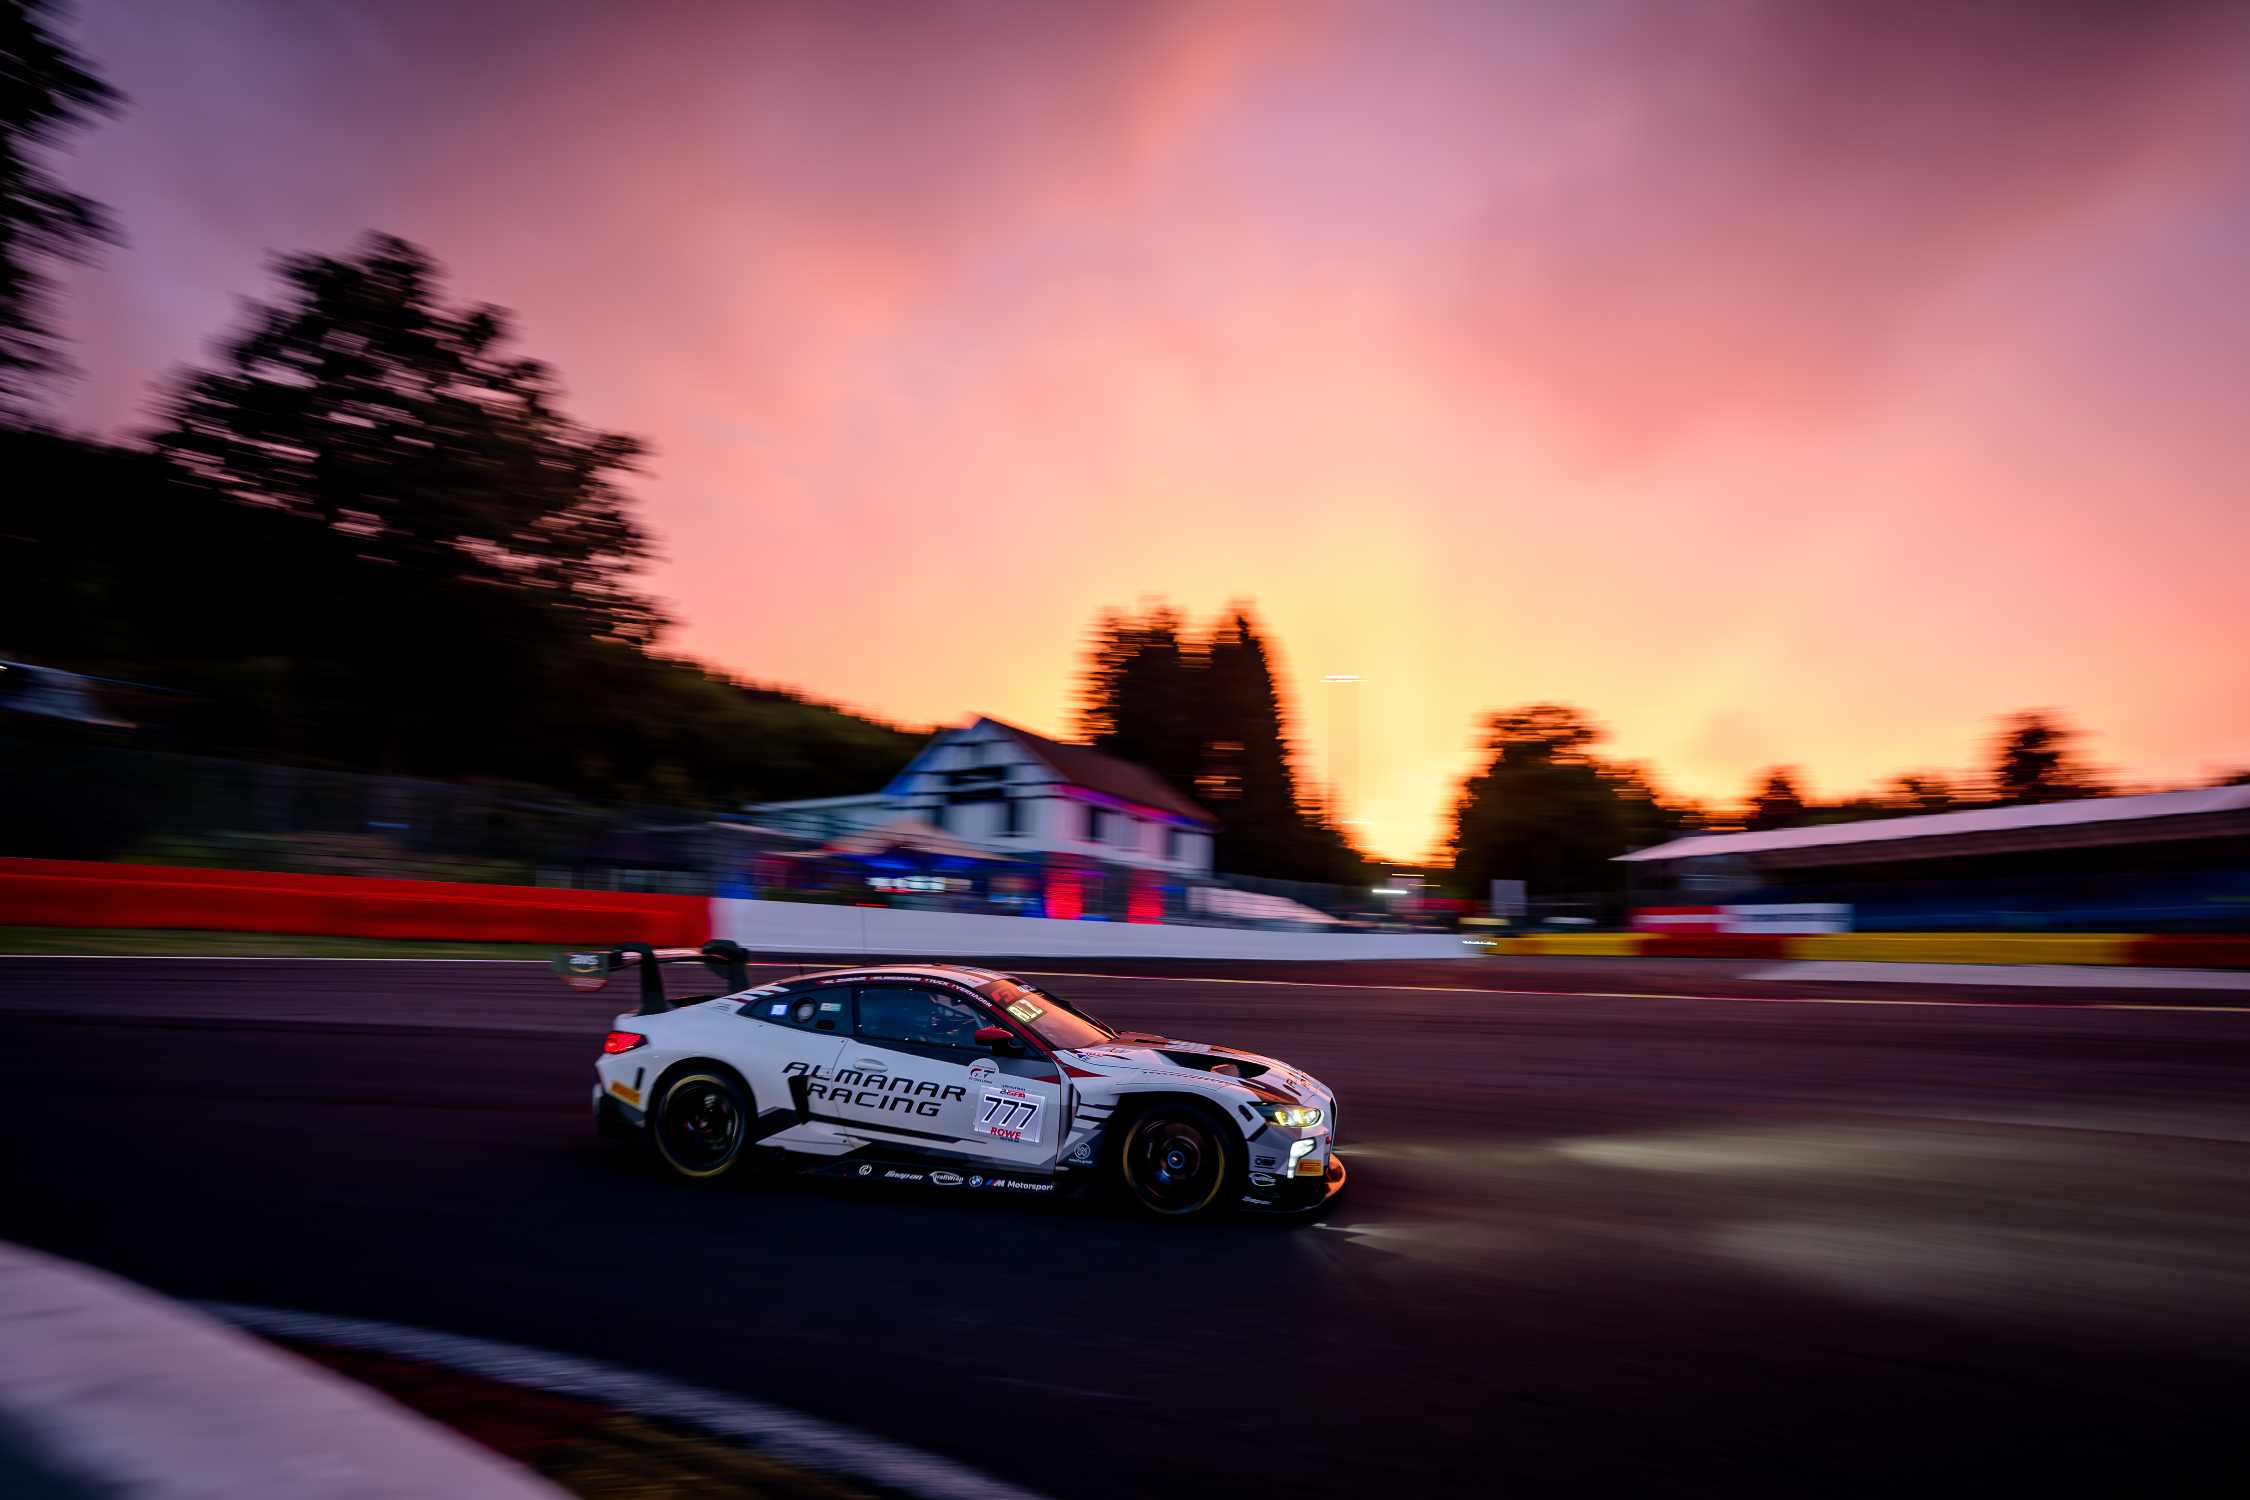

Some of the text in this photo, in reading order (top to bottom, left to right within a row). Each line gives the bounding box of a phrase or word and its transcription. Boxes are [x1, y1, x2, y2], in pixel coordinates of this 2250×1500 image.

[781, 1061, 967, 1102] ALMANAR
[805, 1082, 942, 1118] RACING
[982, 1095, 1039, 1129] 777
[991, 1126, 1022, 1140] ROWE
[1007, 1180, 1054, 1192] Motorsport
